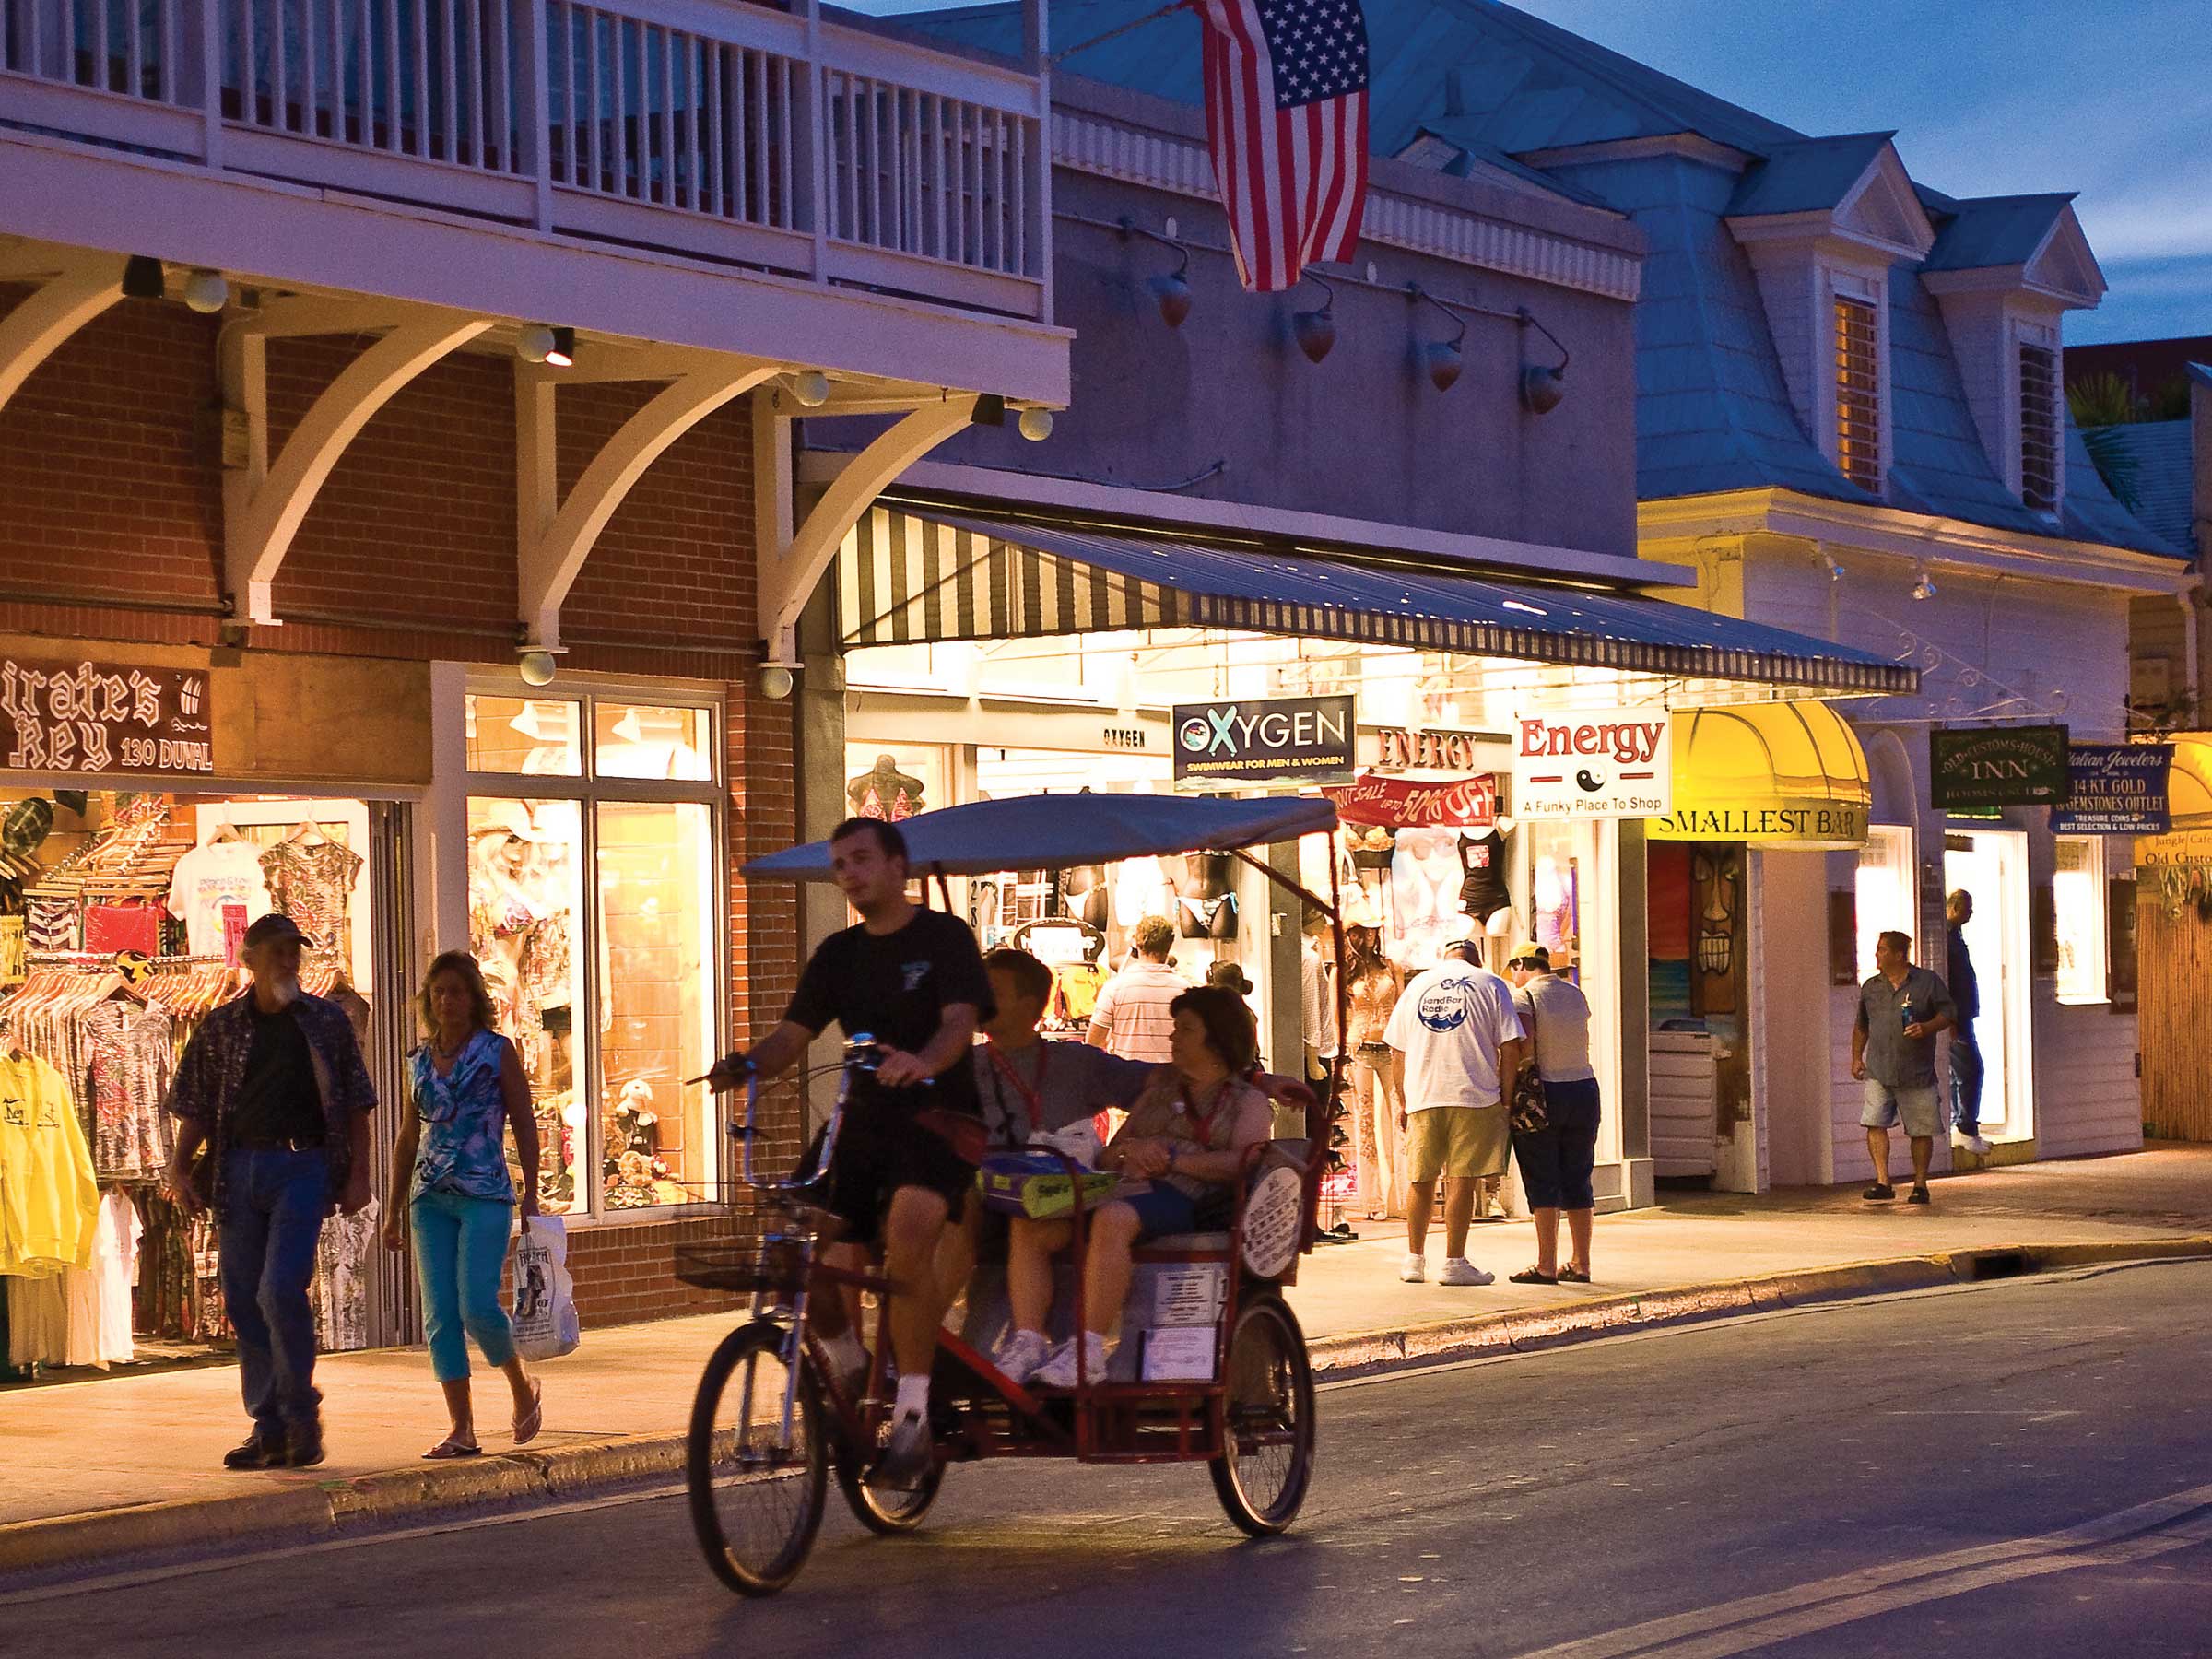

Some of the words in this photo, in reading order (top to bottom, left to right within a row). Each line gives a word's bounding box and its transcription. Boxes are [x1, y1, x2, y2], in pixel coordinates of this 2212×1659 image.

[1103, 728, 1145, 747] OXYGEN
[1180, 706, 1346, 757] OXYGEN
[1379, 729, 1477, 770] ENERGY
[1520, 719, 1665, 764] Energy
[121, 737, 156, 767] 130
[159, 739, 213, 771] DUVAL
[2102, 751, 2162, 773] Jewelers
[1186, 759, 1244, 772] SWIMWEAR
[1245, 759, 1265, 770] FOR
[1266, 758, 1290, 769] MEN
[1291, 757, 1300, 767] &
[1301, 756, 1345, 767] WOMEN
[1971, 759, 2029, 780] INN
[1353, 782, 1387, 802] SALE
[2112, 779, 2147, 794] GOLD
[1394, 788, 1445, 822] 50%
[1445, 779, 1494, 818] OFF
[1524, 801, 1532, 813] A
[1535, 800, 1571, 815] Funky
[1576, 799, 1608, 812] Place
[1613, 797, 1627, 810] To
[1630, 797, 1662, 812] Shop
[2124, 795, 2164, 812] OUTLET
[1658, 810, 1812, 834] SMALLEST
[1817, 810, 1854, 836] BAR
[2059, 823, 2075, 831] BEST
[2077, 822, 2112, 831] SELECTION
[2119, 823, 2136, 831] LOW
[2136, 822, 2160, 831] PRICES
[2074, 814, 2109, 823] TREASURE
[2110, 814, 2131, 822] COINS
[2155, 835, 2185, 848] Jungle
[2145, 853, 2169, 865] Old
